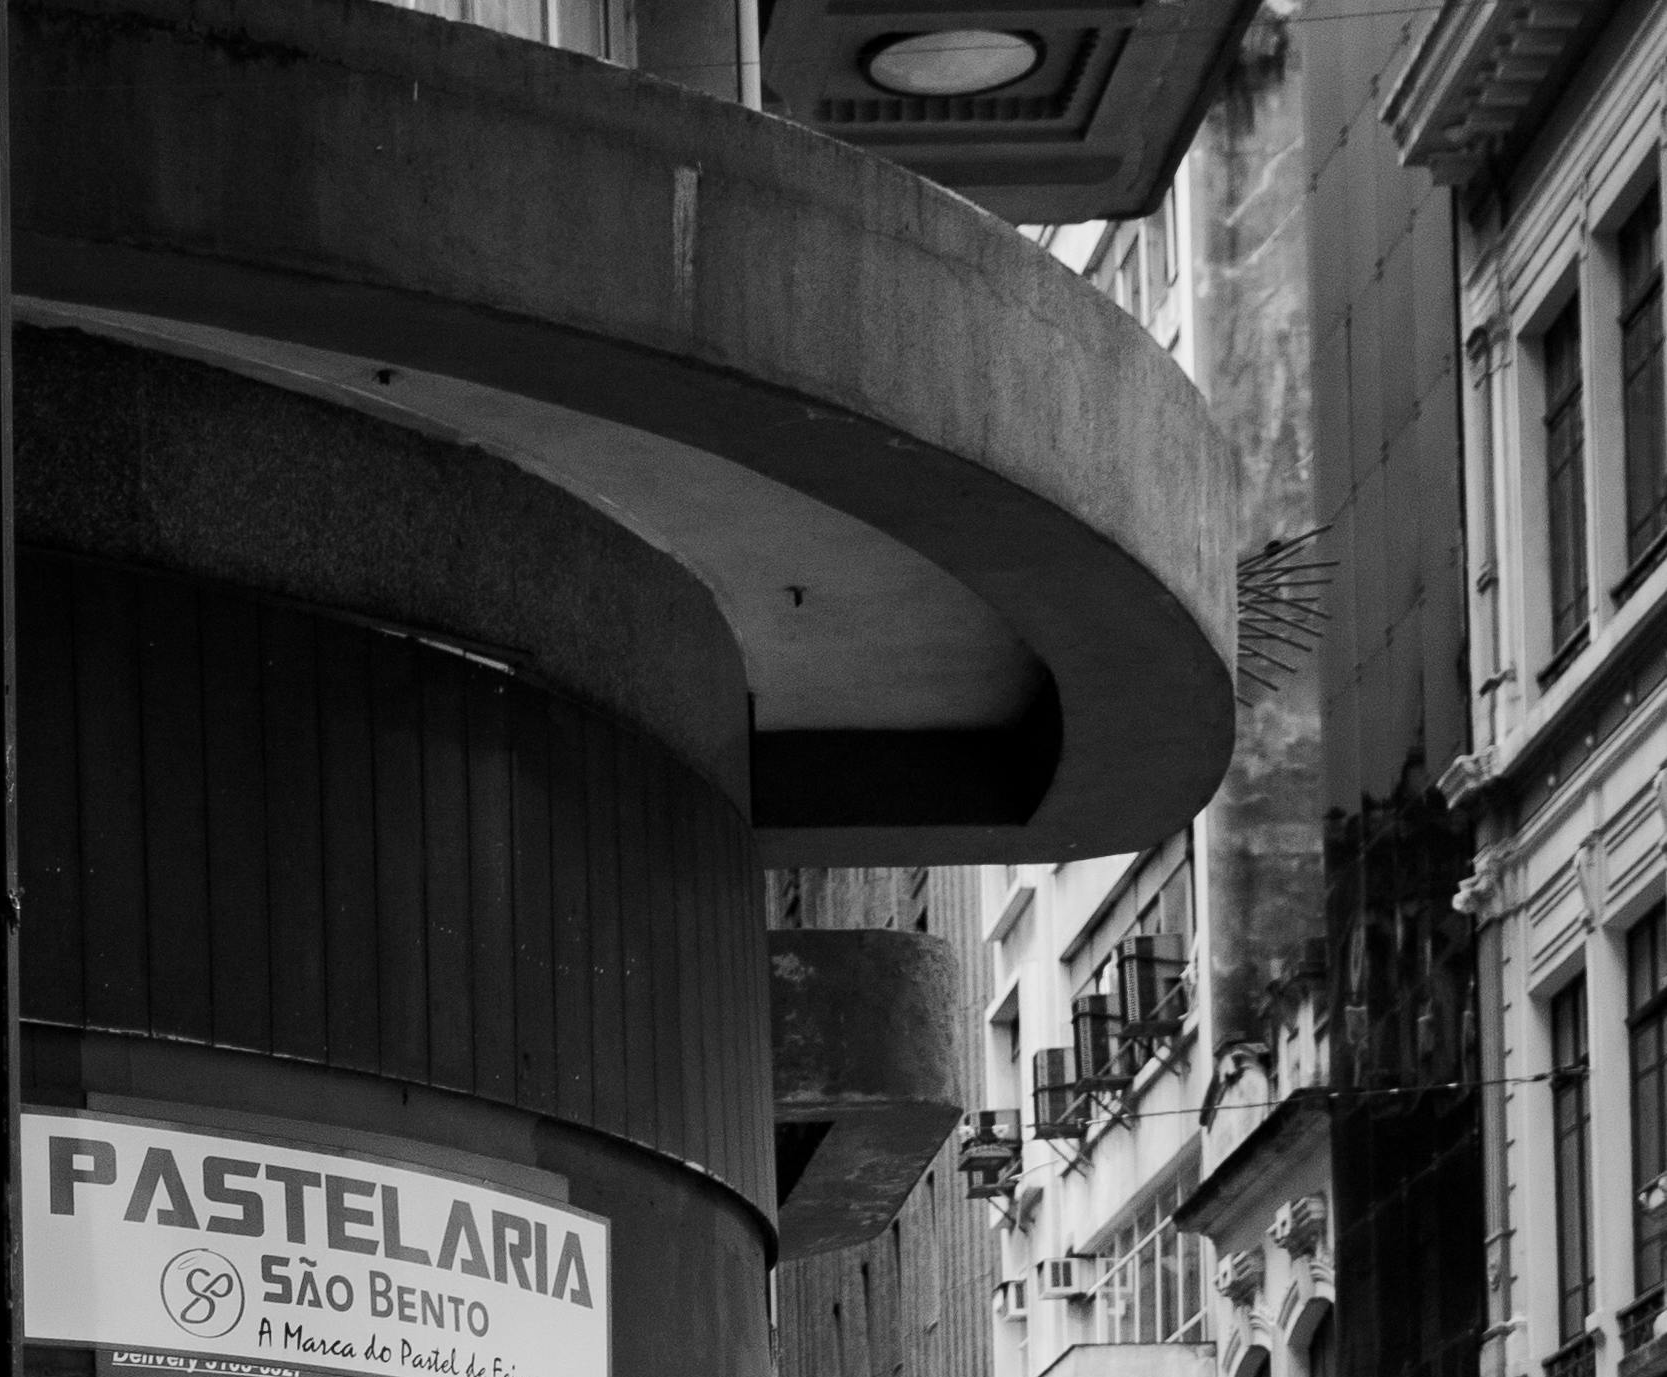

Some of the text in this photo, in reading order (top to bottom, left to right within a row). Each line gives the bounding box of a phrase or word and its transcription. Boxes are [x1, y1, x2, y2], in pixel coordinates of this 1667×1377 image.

[48, 1134, 594, 1310] PASTELARIA
[260, 1253, 355, 1313] SÃO
[368, 1269, 490, 1338] BENTO
[258, 1316, 273, 1348] A
[284, 1320, 357, 1358] Marca
[363, 1332, 392, 1363] do
[400, 1337, 460, 1376] Pastel
